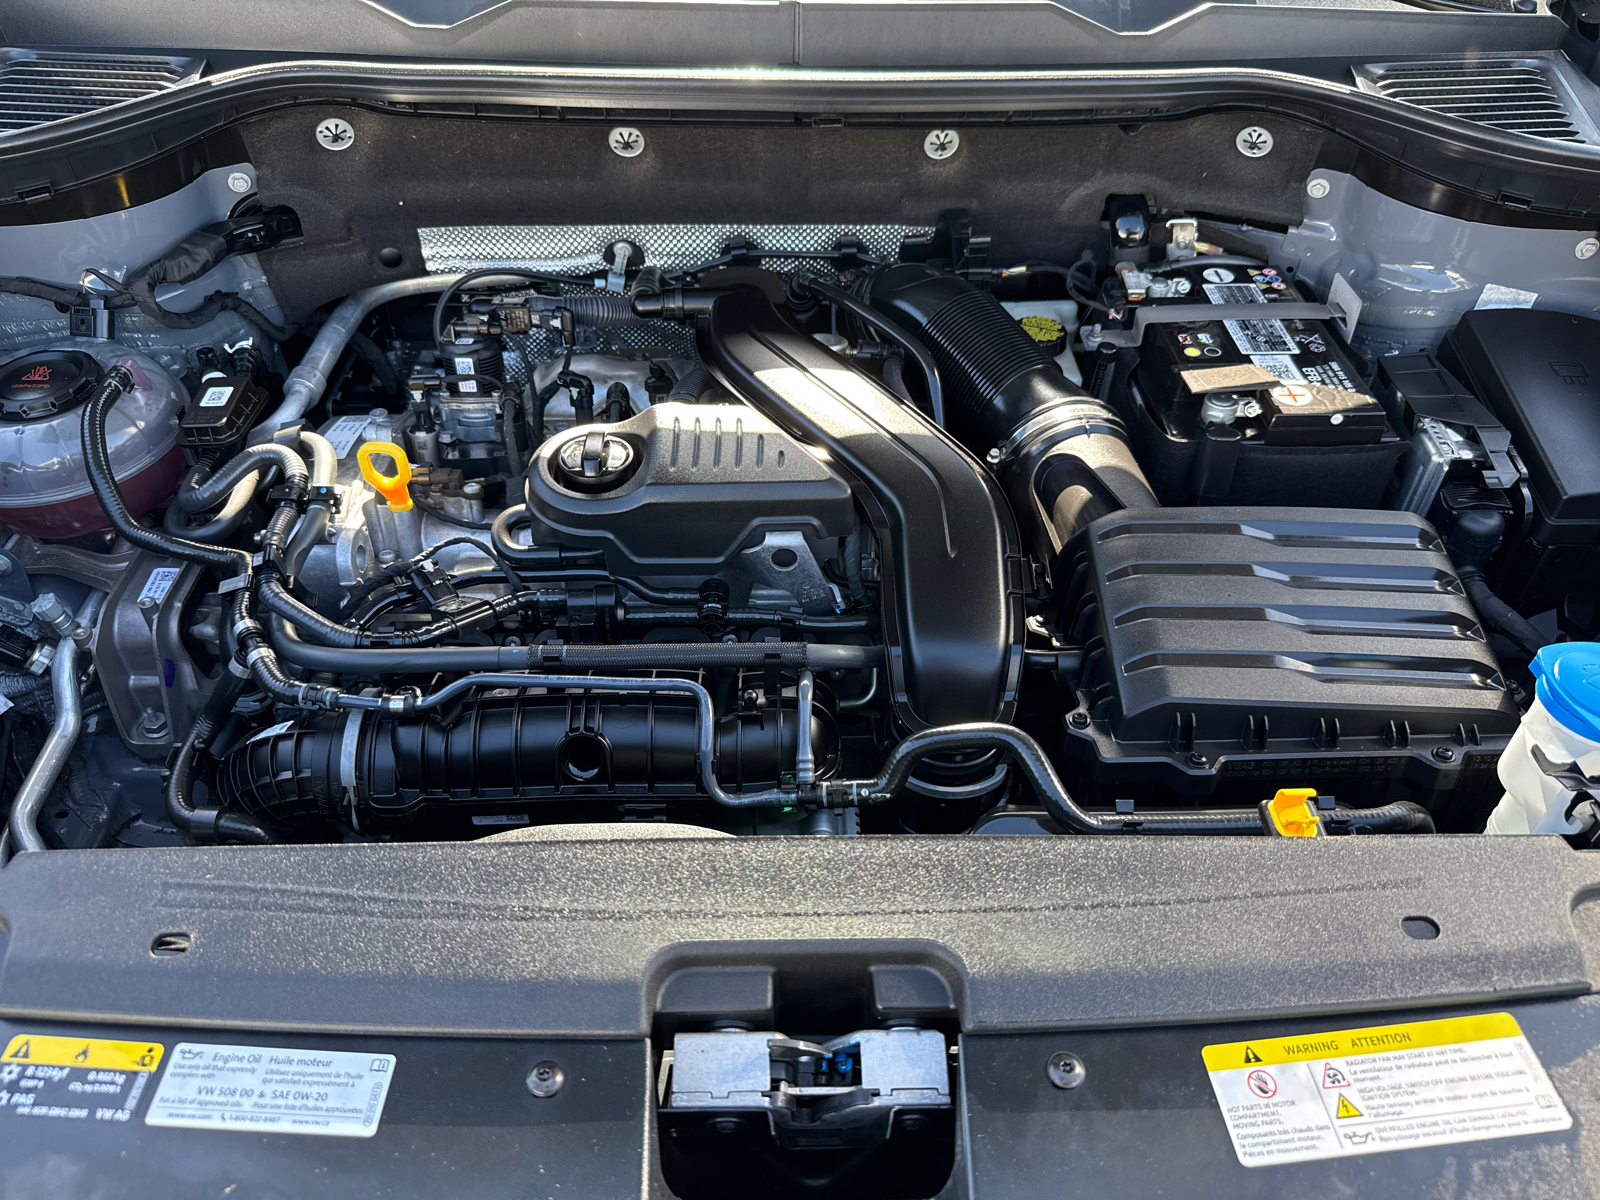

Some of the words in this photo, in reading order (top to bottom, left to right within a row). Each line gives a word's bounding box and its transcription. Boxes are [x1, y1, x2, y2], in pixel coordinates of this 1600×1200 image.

[1283, 1040, 1339, 1056] WARNING
[1350, 1032, 1412, 1048] ATTENTION
[213, 1052, 248, 1065] Engine
[247, 1054, 262, 1064] Oil
[269, 1055, 295, 1066] Huile
[296, 1058, 333, 1068] moteur
[1344, 1057, 1378, 1066] RADIATOR
[1378, 1056, 1392, 1064] FAN
[1392, 1054, 1406, 1062] MAY
[1406, 1051, 1426, 1060] START
[173, 1062, 187, 1070] Use
[187, 1063, 202, 1072] only
[226, 1065, 258, 1074] expressly
[265, 1068, 290, 1076] Utilisez
[290, 1070, 332, 1079] uniquement
[333, 1071, 342, 1079] de
[1359, 1065, 1394, 1074] ventilateur
[1404, 1061, 1434, 1070] radiateur
[262, 1076, 274, 1086] qui
[274, 1077, 302, 1085] satisfait
[302, 1079, 350, 1088] expressément
[1357, 1086, 1374, 1094] HIGH
[1405, 1079, 1430, 1088] SWITCH
[1430, 1078, 1444, 1086] OFF
[1444, 1074, 1468, 1084] ENGINE
[1468, 1072, 1494, 1082] BEFORE
[197, 1085, 217, 1096] VW
[218, 1086, 238, 1097] 508
[239, 1088, 254, 1098] 00
[258, 1090, 267, 1098] &
[271, 1090, 292, 1100] SAE
[293, 1090, 329, 1102] 0W-20
[1360, 1092, 1391, 1102] IGNITION
[177, 1096, 187, 1105] list
[196, 1098, 230, 1108] approved
[252, 1101, 270, 1110] Pour
[284, 1102, 298, 1111] liste
[1226, 1106, 1241, 1114] HOT
[1242, 1103, 1262, 1112] PARTS
[1272, 1100, 1296, 1108] MOTOR
[1364, 1102, 1386, 1110] Haute
[1230, 1110, 1282, 1122] COMPARTMENT.
[1232, 1120, 1260, 1130] MOVING
[1374, 1124, 1415, 1134] OVERFILLED
[1416, 1120, 1440, 1129] ENGINE
[1440, 1118, 1452, 1126] OIL
[1452, 1116, 1468, 1124] CAN
[1236, 1130, 1277, 1140] Composants
[1277, 1128, 1290, 1136] très
[1290, 1125, 1314, 1134] chauds
[1314, 1124, 1330, 1132] dans
[1378, 1132, 1422, 1142] Remplissage
[1248, 1136, 1296, 1148] compartiment
[1242, 1148, 1265, 1158] Pièces
